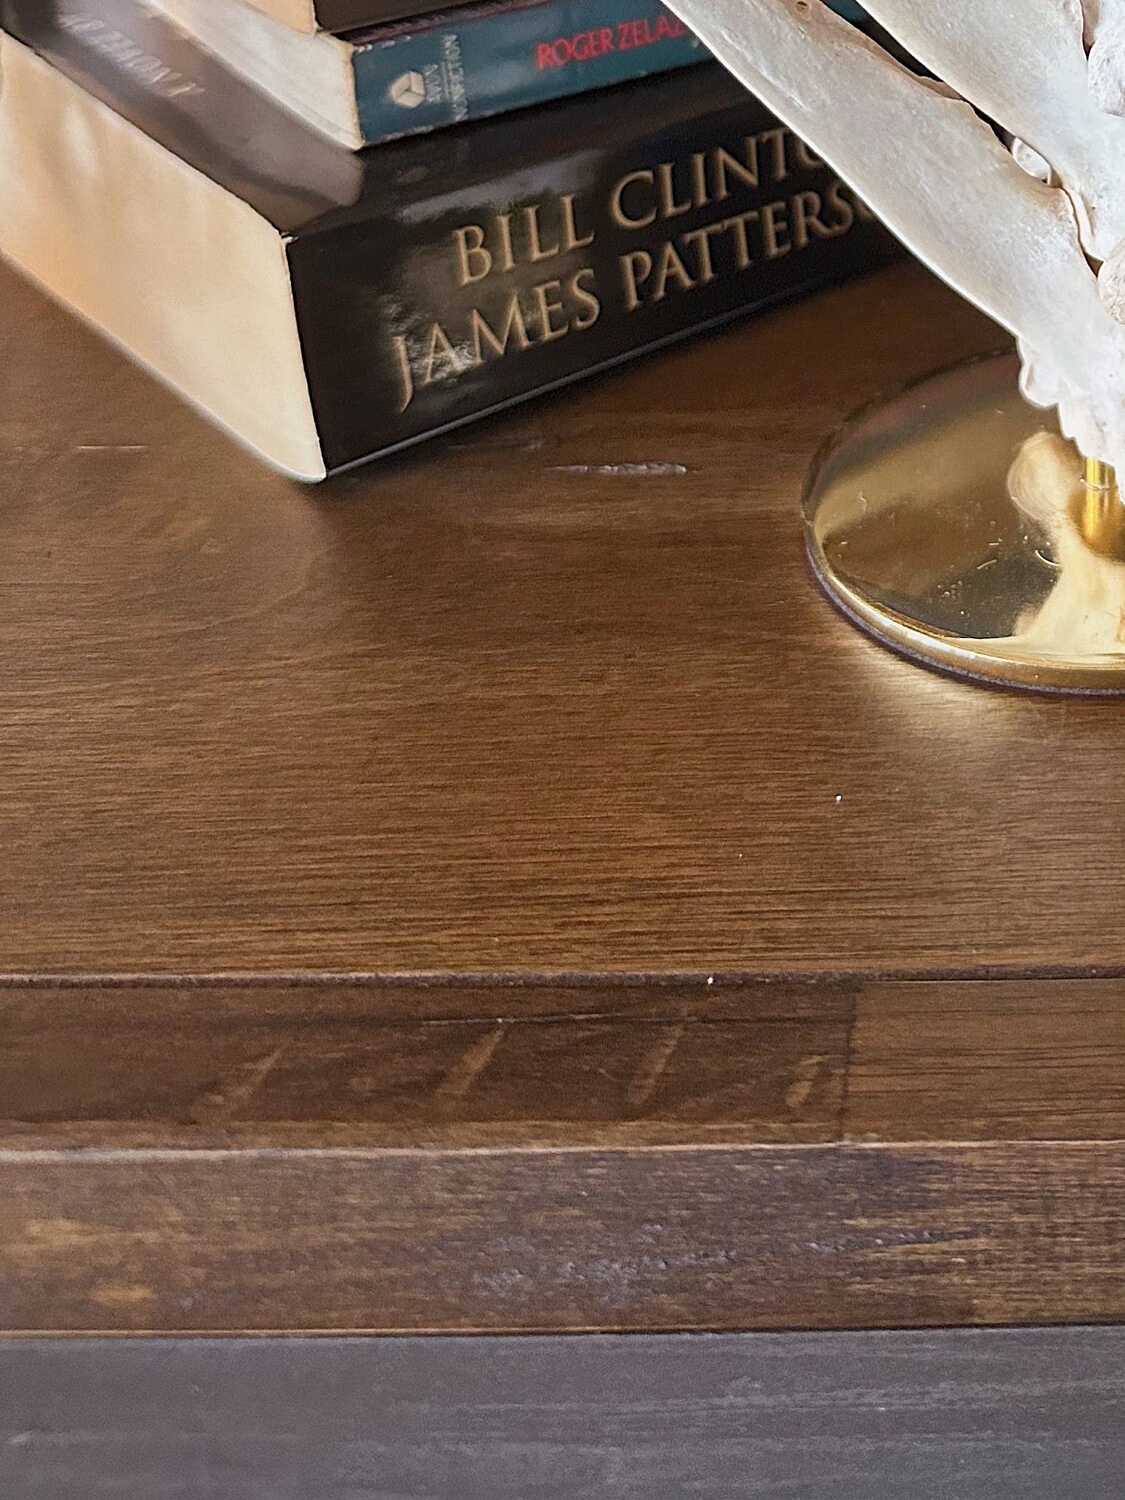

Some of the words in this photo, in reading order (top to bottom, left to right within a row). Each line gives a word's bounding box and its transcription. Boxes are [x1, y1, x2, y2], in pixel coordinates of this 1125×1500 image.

[535, 26, 615, 71] ROGER
[451, 194, 596, 288] BILL
[393, 268, 602, 414] JAMES
